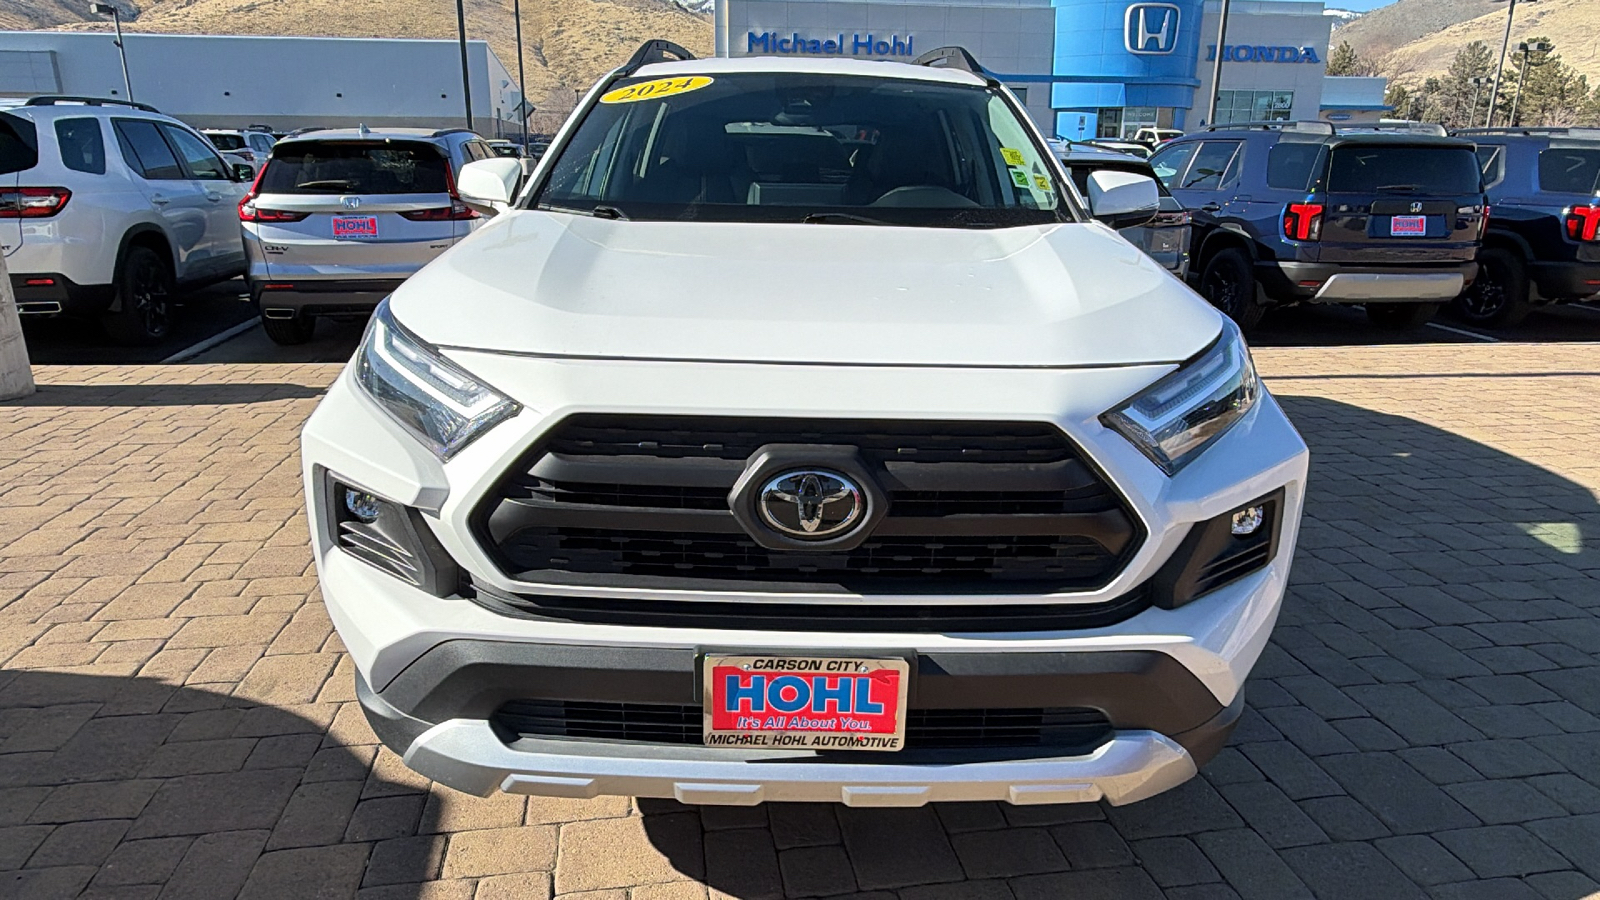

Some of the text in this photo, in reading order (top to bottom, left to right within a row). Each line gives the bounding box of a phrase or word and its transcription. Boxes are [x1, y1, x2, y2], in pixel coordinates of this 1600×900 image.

[747, 31, 913, 56] Michael Hohl
[1205, 44, 1320, 63] HONDA
[618, 77, 694, 100] 2024
[336, 220, 374, 230] HOHL
[752, 659, 864, 672] CARSON CITY
[725, 674, 885, 714] HOHL
[737, 716, 872, 730] It's All About You.
[709, 734, 900, 748] MICHAEL HOHL AUTOMOTIVE
